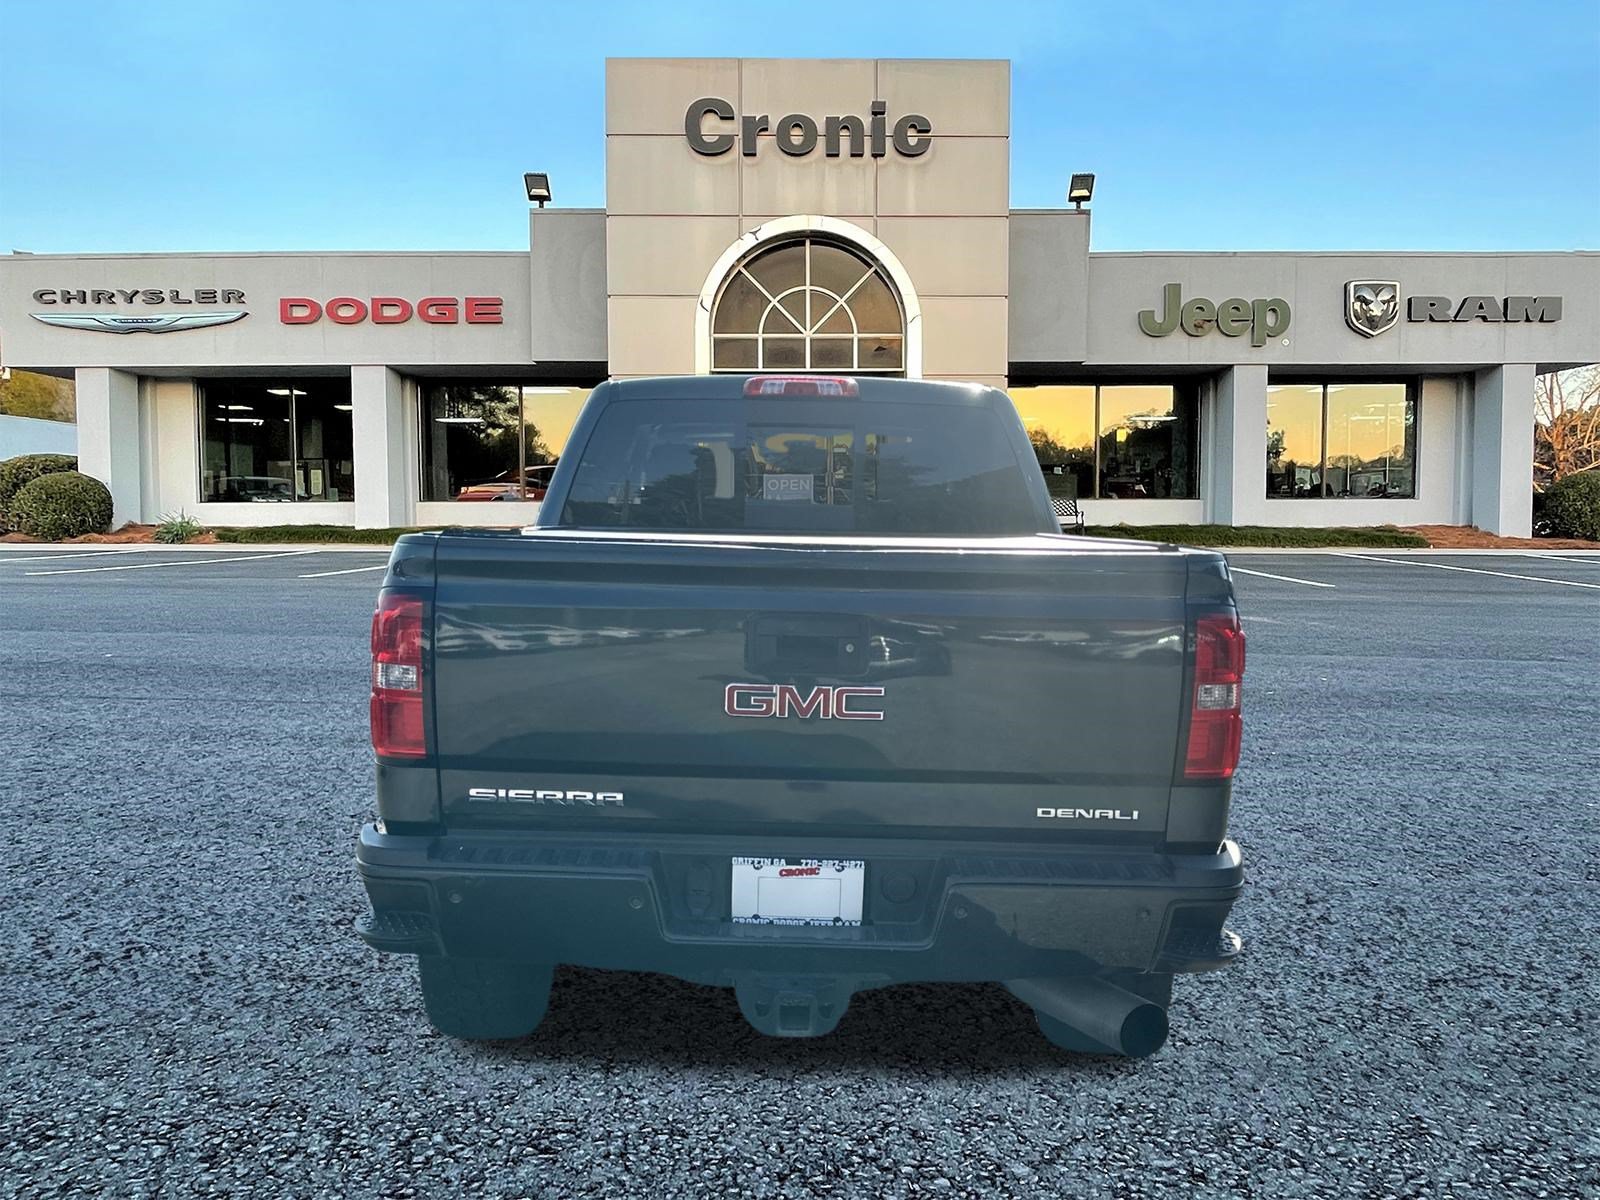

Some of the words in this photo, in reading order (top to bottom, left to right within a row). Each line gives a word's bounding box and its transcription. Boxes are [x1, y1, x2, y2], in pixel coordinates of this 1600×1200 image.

[685, 97, 932, 157] Cronic
[32, 288, 247, 305] CHRYSLER
[280, 297, 504, 325] DODGE
[1138, 283, 1292, 347] Jeep
[1407, 296, 1563, 323] RAM
[768, 479, 810, 490] OPEN
[724, 683, 885, 720] GMC
[468, 787, 625, 807] SIERRA
[1036, 807, 1139, 820] DENALI
[773, 858, 787, 867] GA
[779, 868, 820, 877] CRONIC
